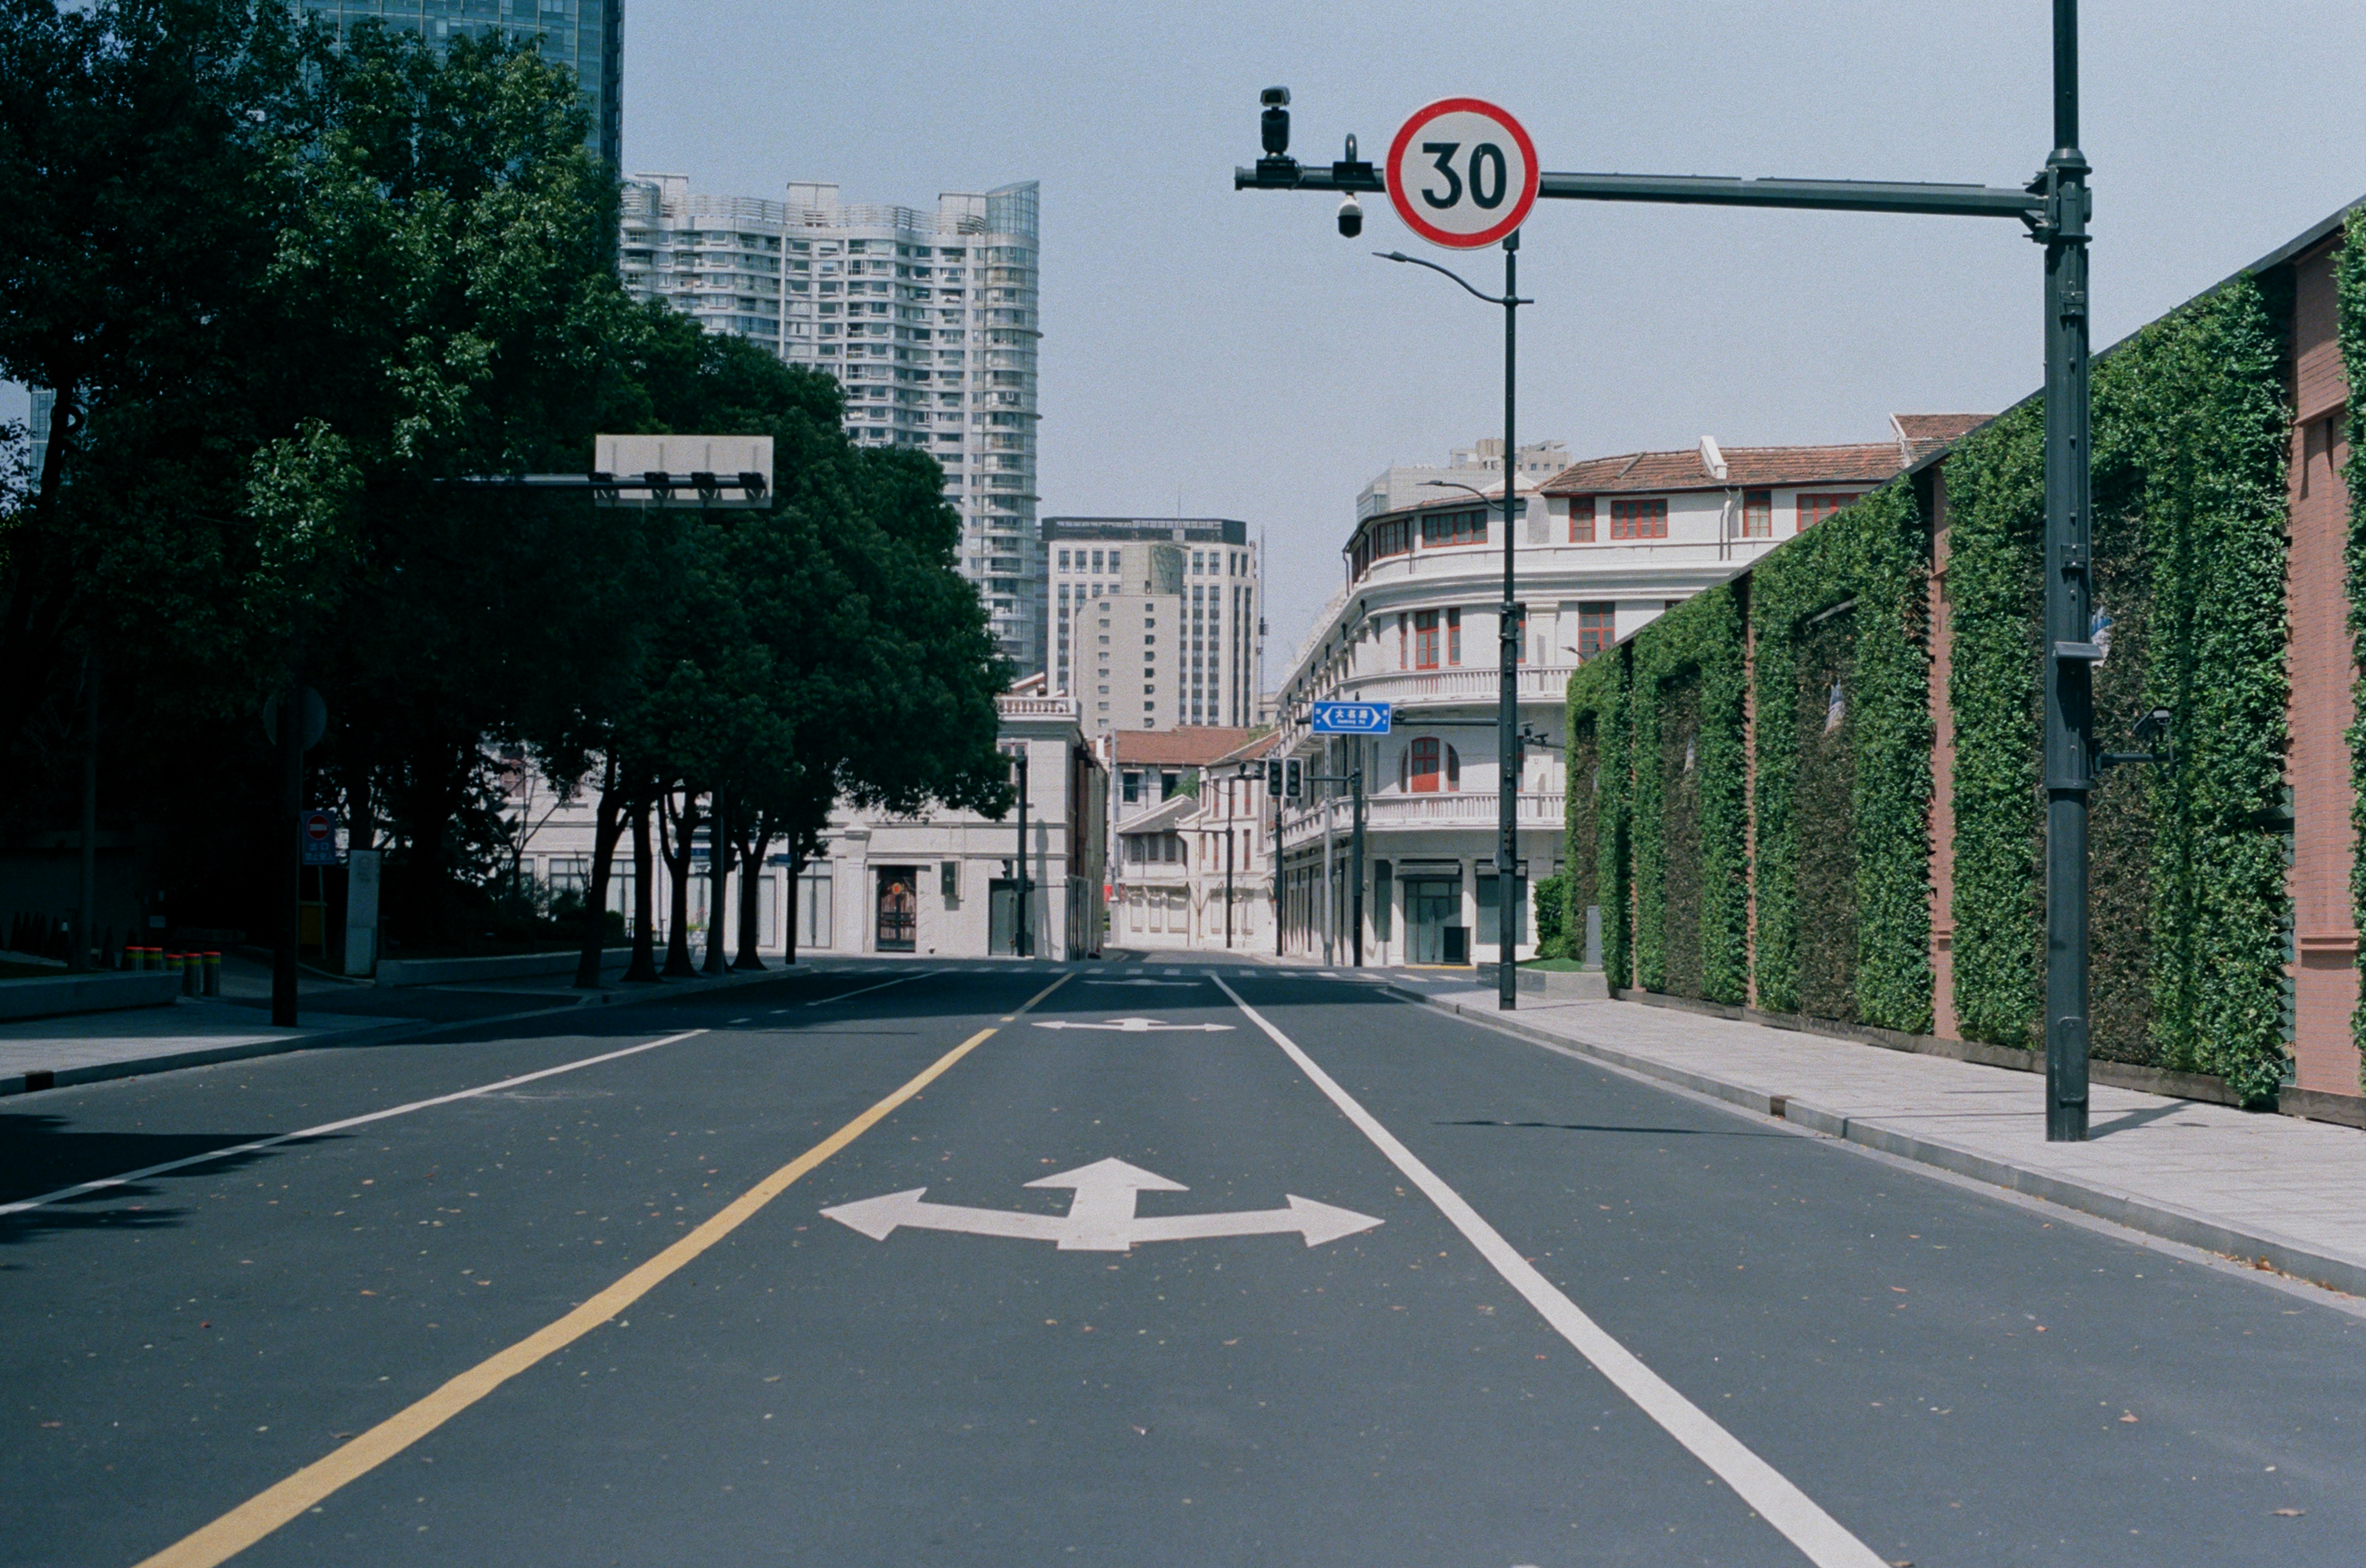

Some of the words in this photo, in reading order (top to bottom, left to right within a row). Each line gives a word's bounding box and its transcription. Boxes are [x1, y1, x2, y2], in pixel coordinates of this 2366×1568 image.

[1421, 143, 1507, 209] 30
[1335, 709, 1368, 719] 大名路
